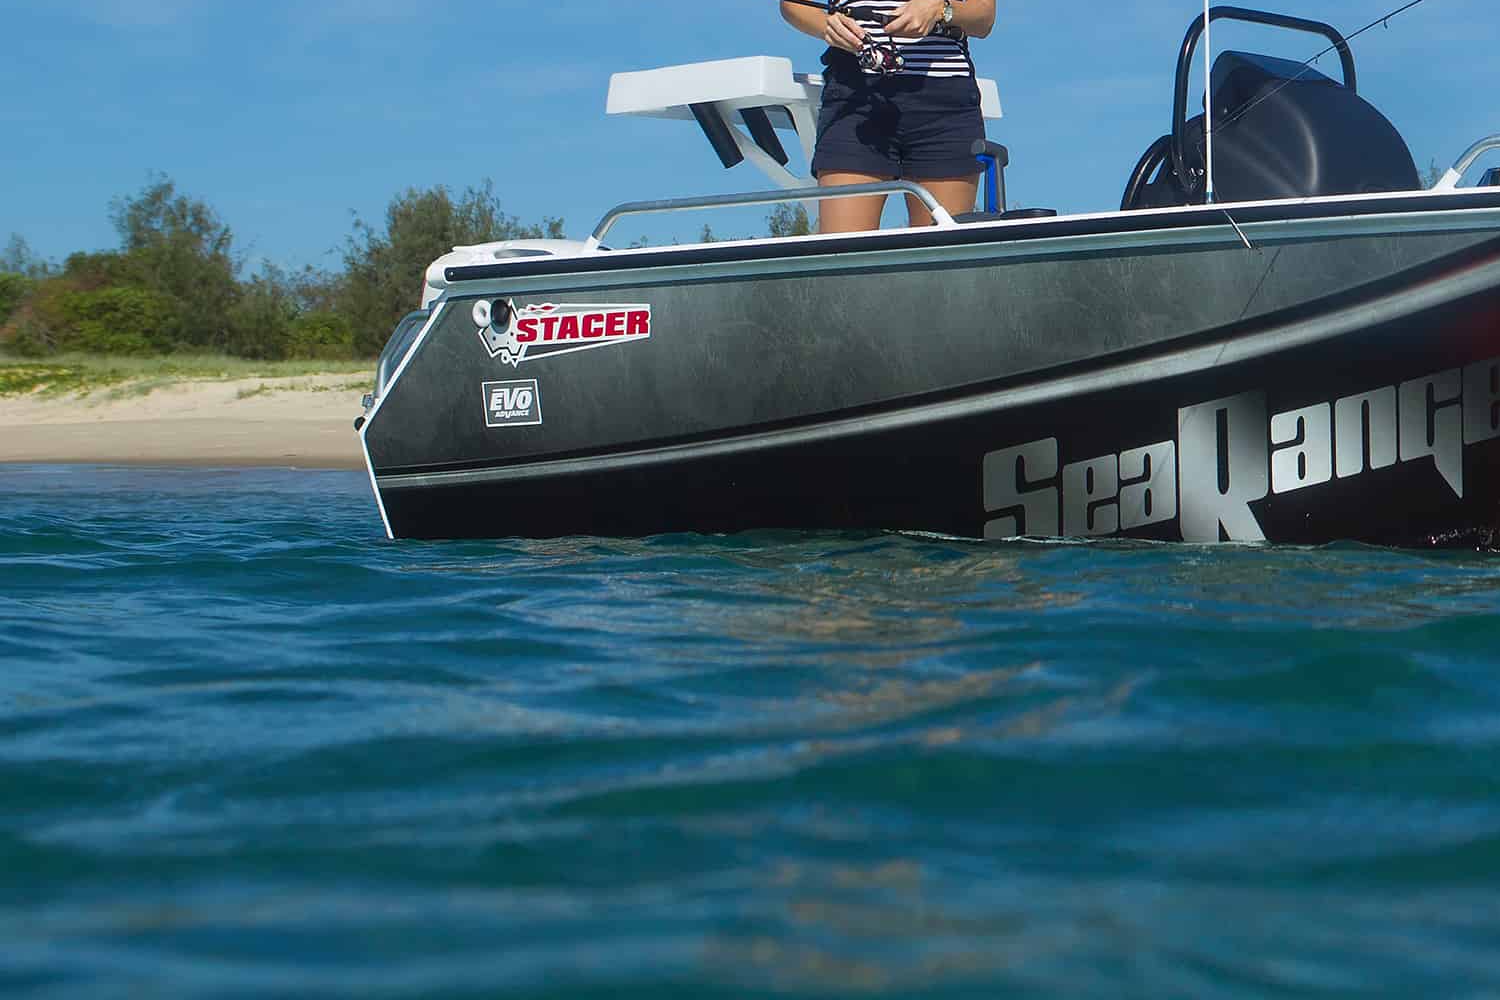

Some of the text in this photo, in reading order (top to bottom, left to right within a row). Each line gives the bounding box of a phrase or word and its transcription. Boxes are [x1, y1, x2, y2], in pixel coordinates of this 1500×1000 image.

[516, 310, 650, 343] STACER
[490, 387, 532, 411] EVO
[495, 410, 529, 419] ADVANCE
